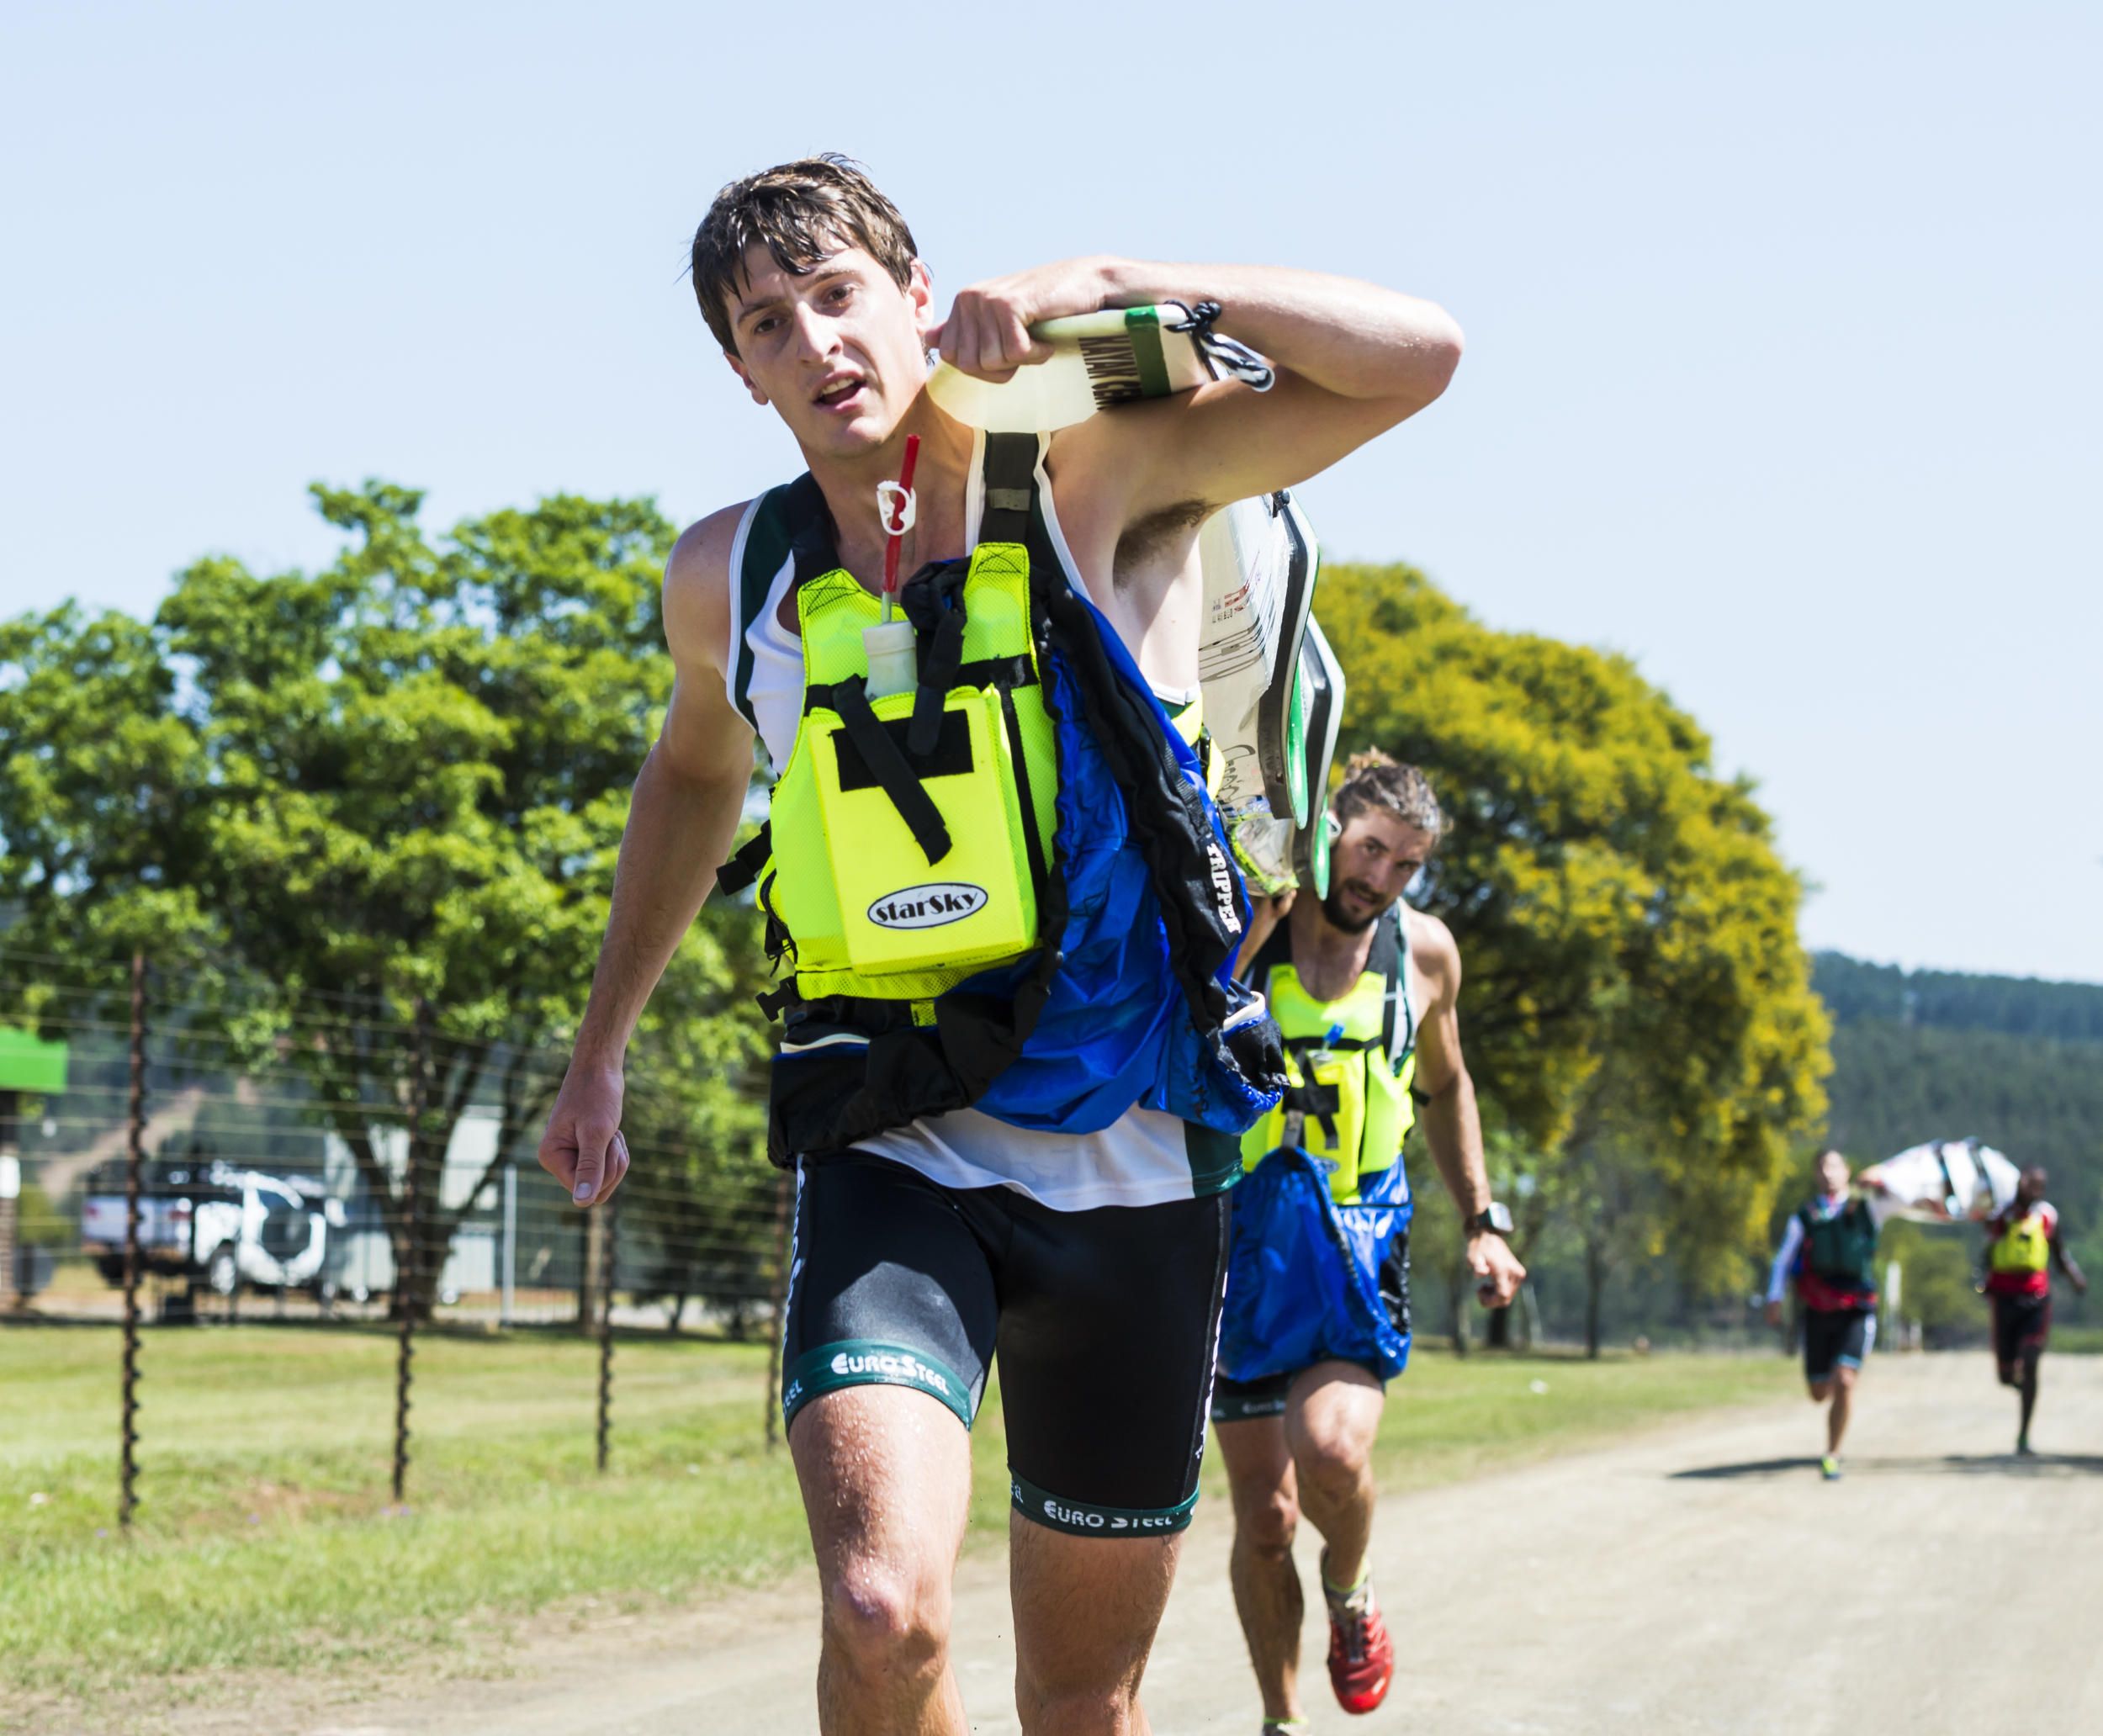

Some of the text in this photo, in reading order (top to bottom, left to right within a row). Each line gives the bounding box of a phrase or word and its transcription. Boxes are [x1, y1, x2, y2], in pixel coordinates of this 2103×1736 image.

[1078, 335, 1140, 379] KAYAK
[876, 892, 978, 923] starSky
[1206, 843, 1242, 934] TRIPPER
